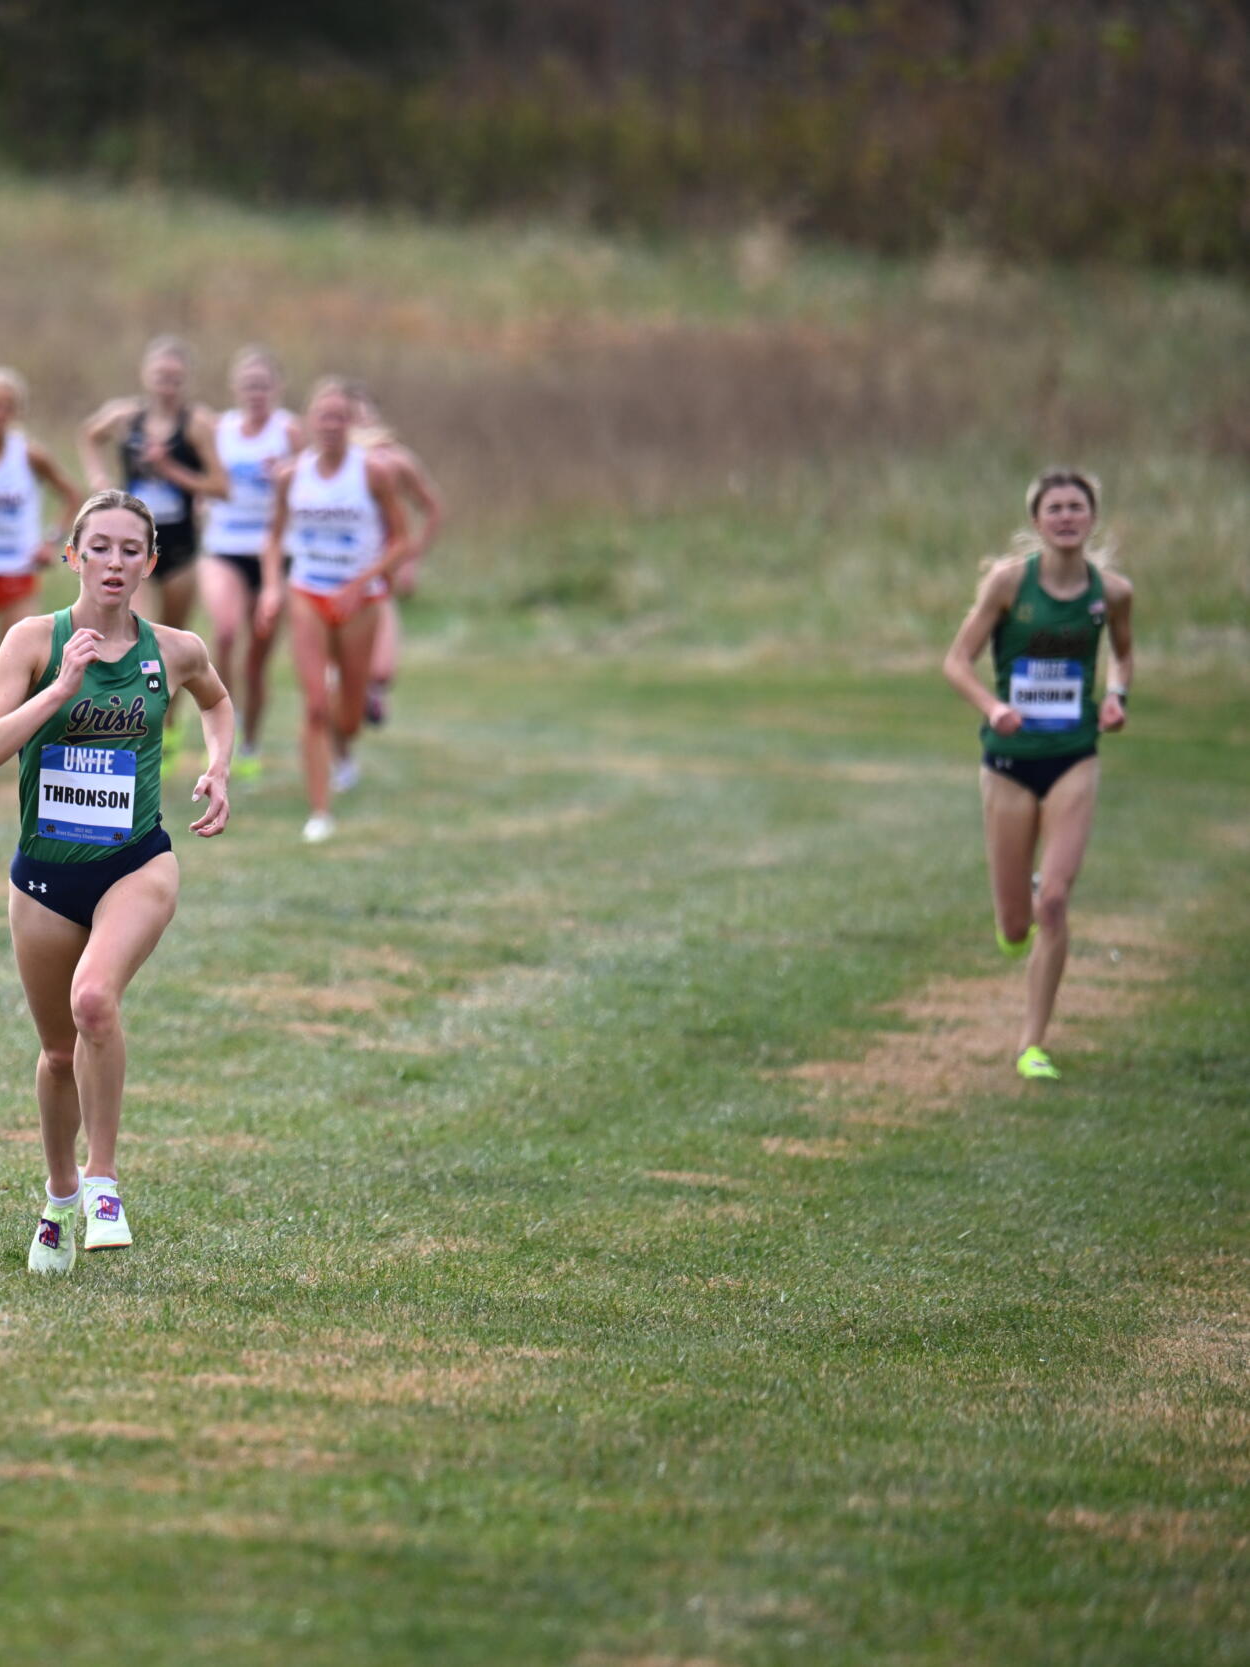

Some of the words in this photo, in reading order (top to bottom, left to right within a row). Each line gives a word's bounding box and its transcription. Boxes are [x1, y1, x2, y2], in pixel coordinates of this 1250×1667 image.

[66, 695, 148, 734] Irish
[63, 746, 116, 774] UNITE
[43, 784, 130, 809] THRONSON
